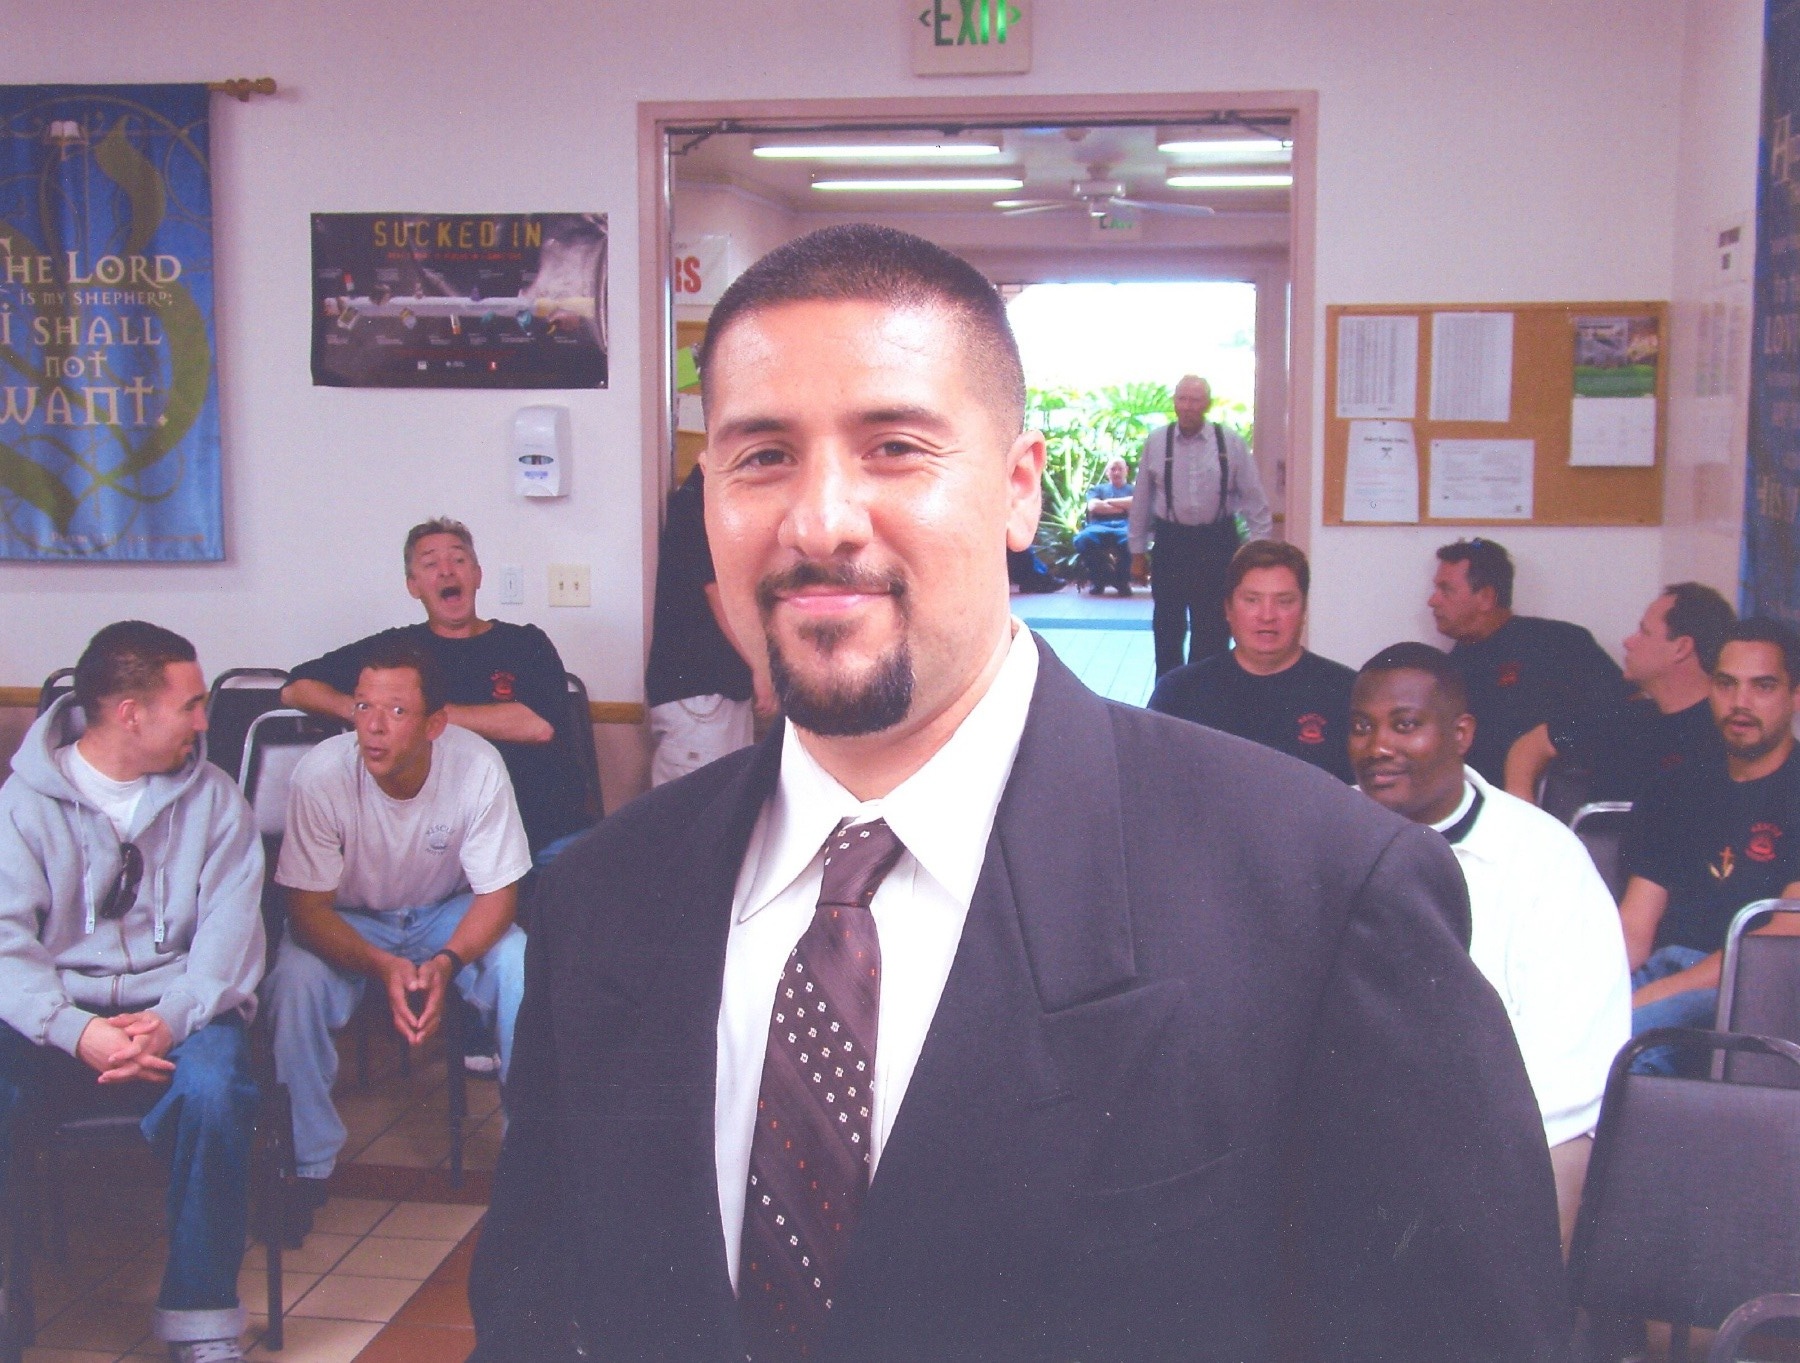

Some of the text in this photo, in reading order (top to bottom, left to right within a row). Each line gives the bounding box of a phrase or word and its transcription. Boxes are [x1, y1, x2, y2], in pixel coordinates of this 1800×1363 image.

[372, 220, 542, 249] SUCKED IN
[66, 250, 182, 288] LORD
[33, 315, 163, 346] SHALL
